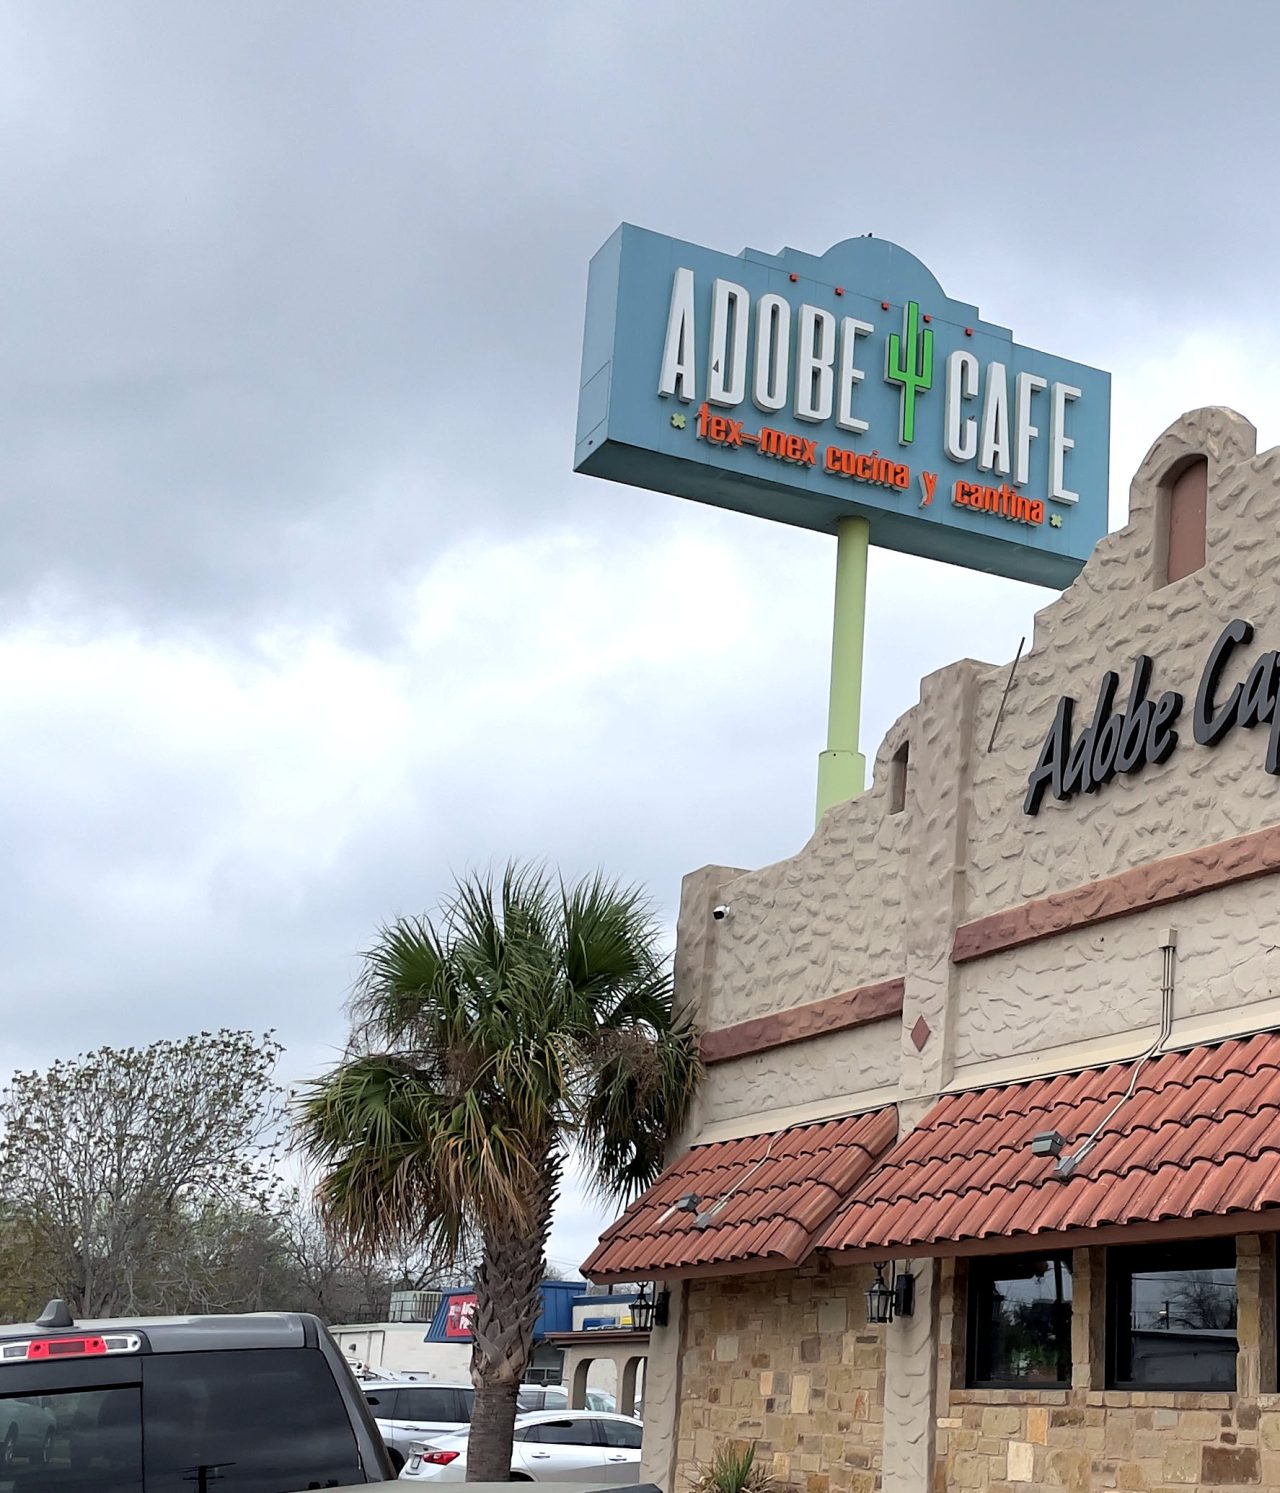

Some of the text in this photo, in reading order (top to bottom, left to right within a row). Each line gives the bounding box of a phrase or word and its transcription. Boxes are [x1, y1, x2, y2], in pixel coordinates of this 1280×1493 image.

[658, 267, 1082, 505] ADOBE CAFE
[696, 402, 1045, 527] tex-mex cocina y cantina
[1024, 655, 1183, 815] Adobe
